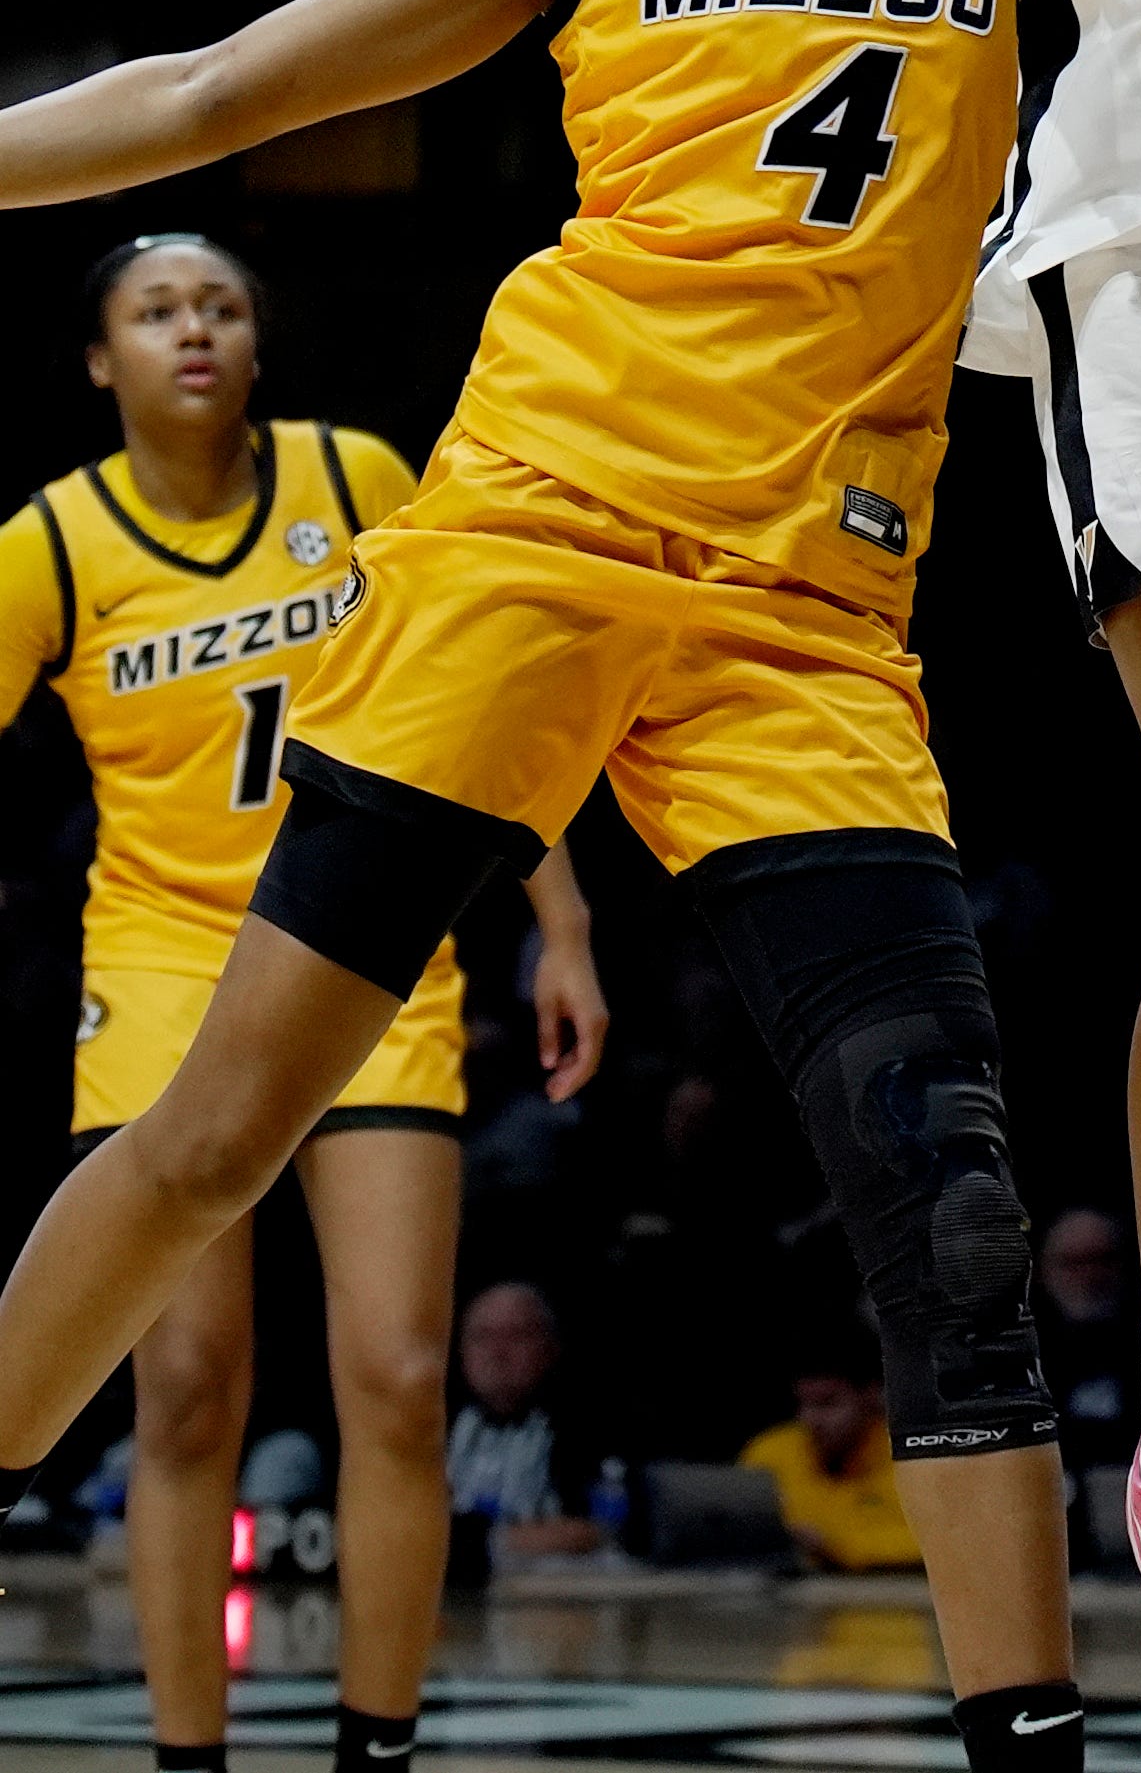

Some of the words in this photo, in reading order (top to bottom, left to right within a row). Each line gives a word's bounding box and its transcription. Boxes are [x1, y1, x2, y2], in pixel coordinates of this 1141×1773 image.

[755, 42, 909, 231] 4
[229, 675, 290, 813] 1
[906, 1428, 1008, 1448] DONJOY
